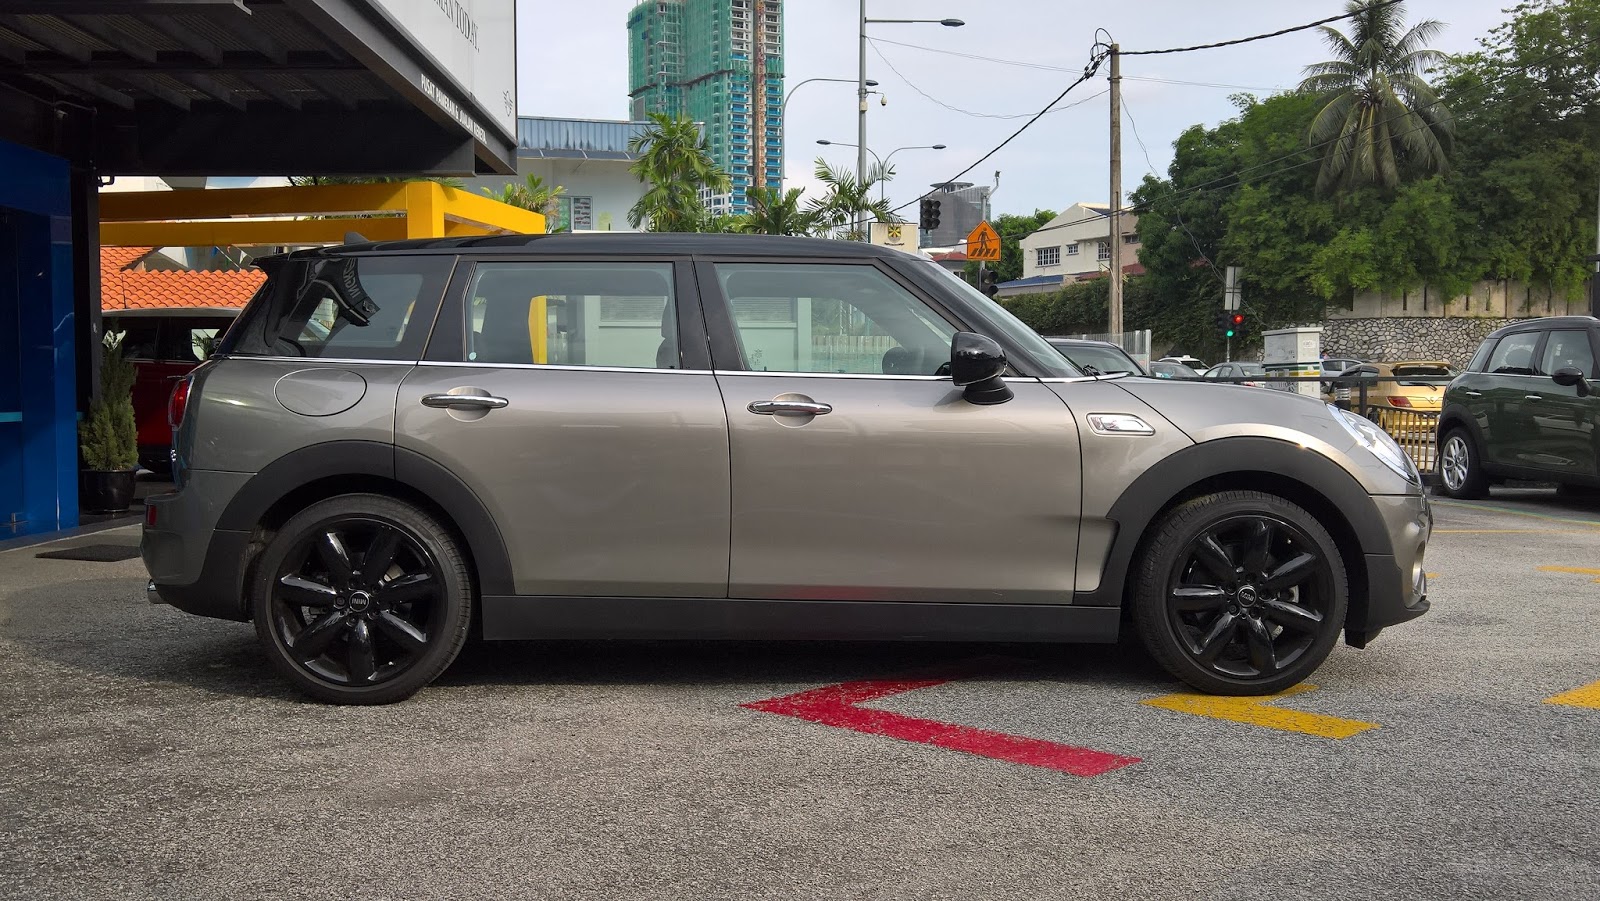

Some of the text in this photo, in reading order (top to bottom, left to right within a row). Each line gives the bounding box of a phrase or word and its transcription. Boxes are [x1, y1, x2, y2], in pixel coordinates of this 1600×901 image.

[455, 0, 480, 53] TODAY.
[421, 73, 435, 98] PUSAT
[436, 87, 456, 116] PAMERAN
